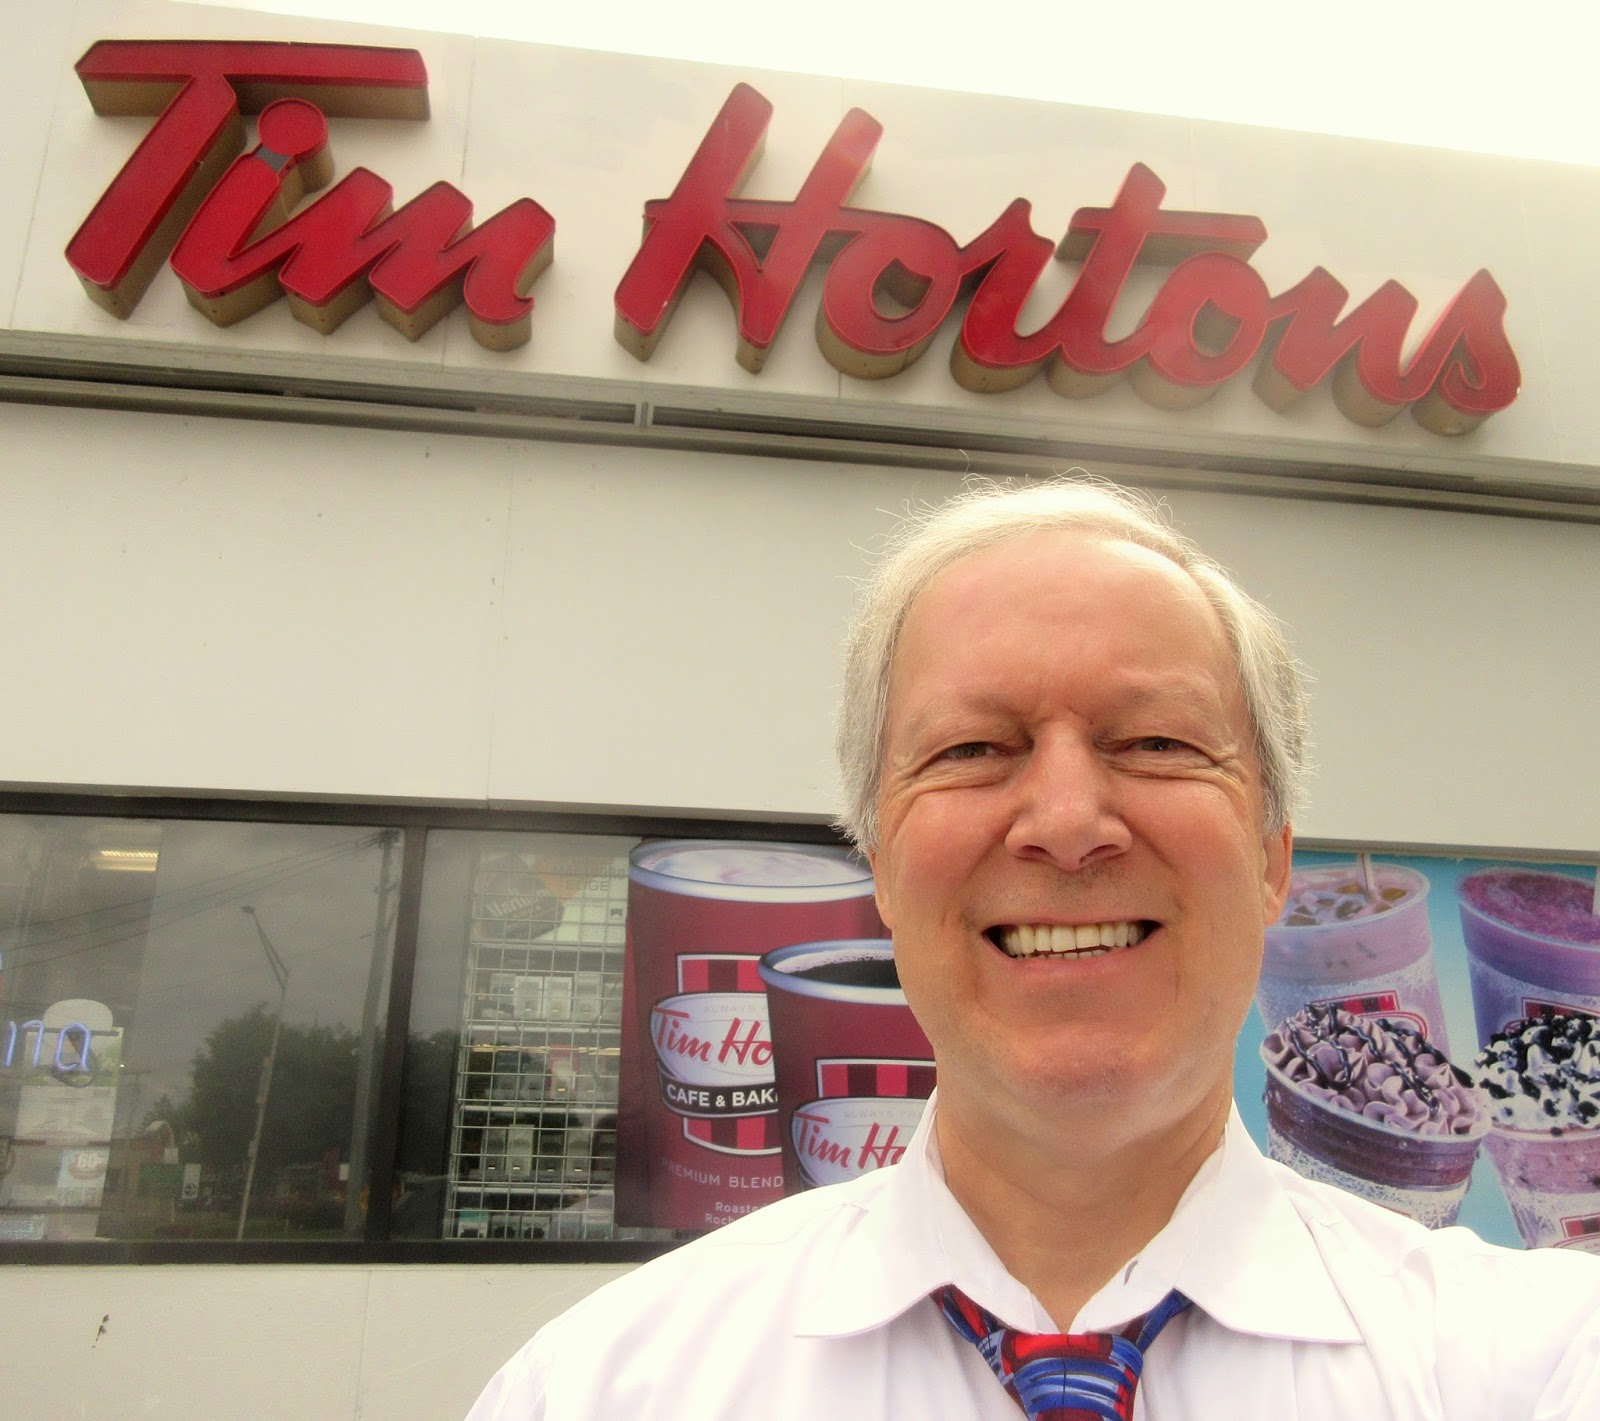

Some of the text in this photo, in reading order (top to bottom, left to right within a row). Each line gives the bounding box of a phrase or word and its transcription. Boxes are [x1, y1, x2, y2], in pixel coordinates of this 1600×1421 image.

[65, 40, 1522, 425] Tim Hortons
[653, 1005, 712, 1062] Tim
[666, 1083, 778, 1107] CAFE & BAK
[794, 1111, 851, 1169] Tim
[660, 1156, 784, 1189] PREMIUM BLEND
[715, 1202, 767, 1214] Roaste
